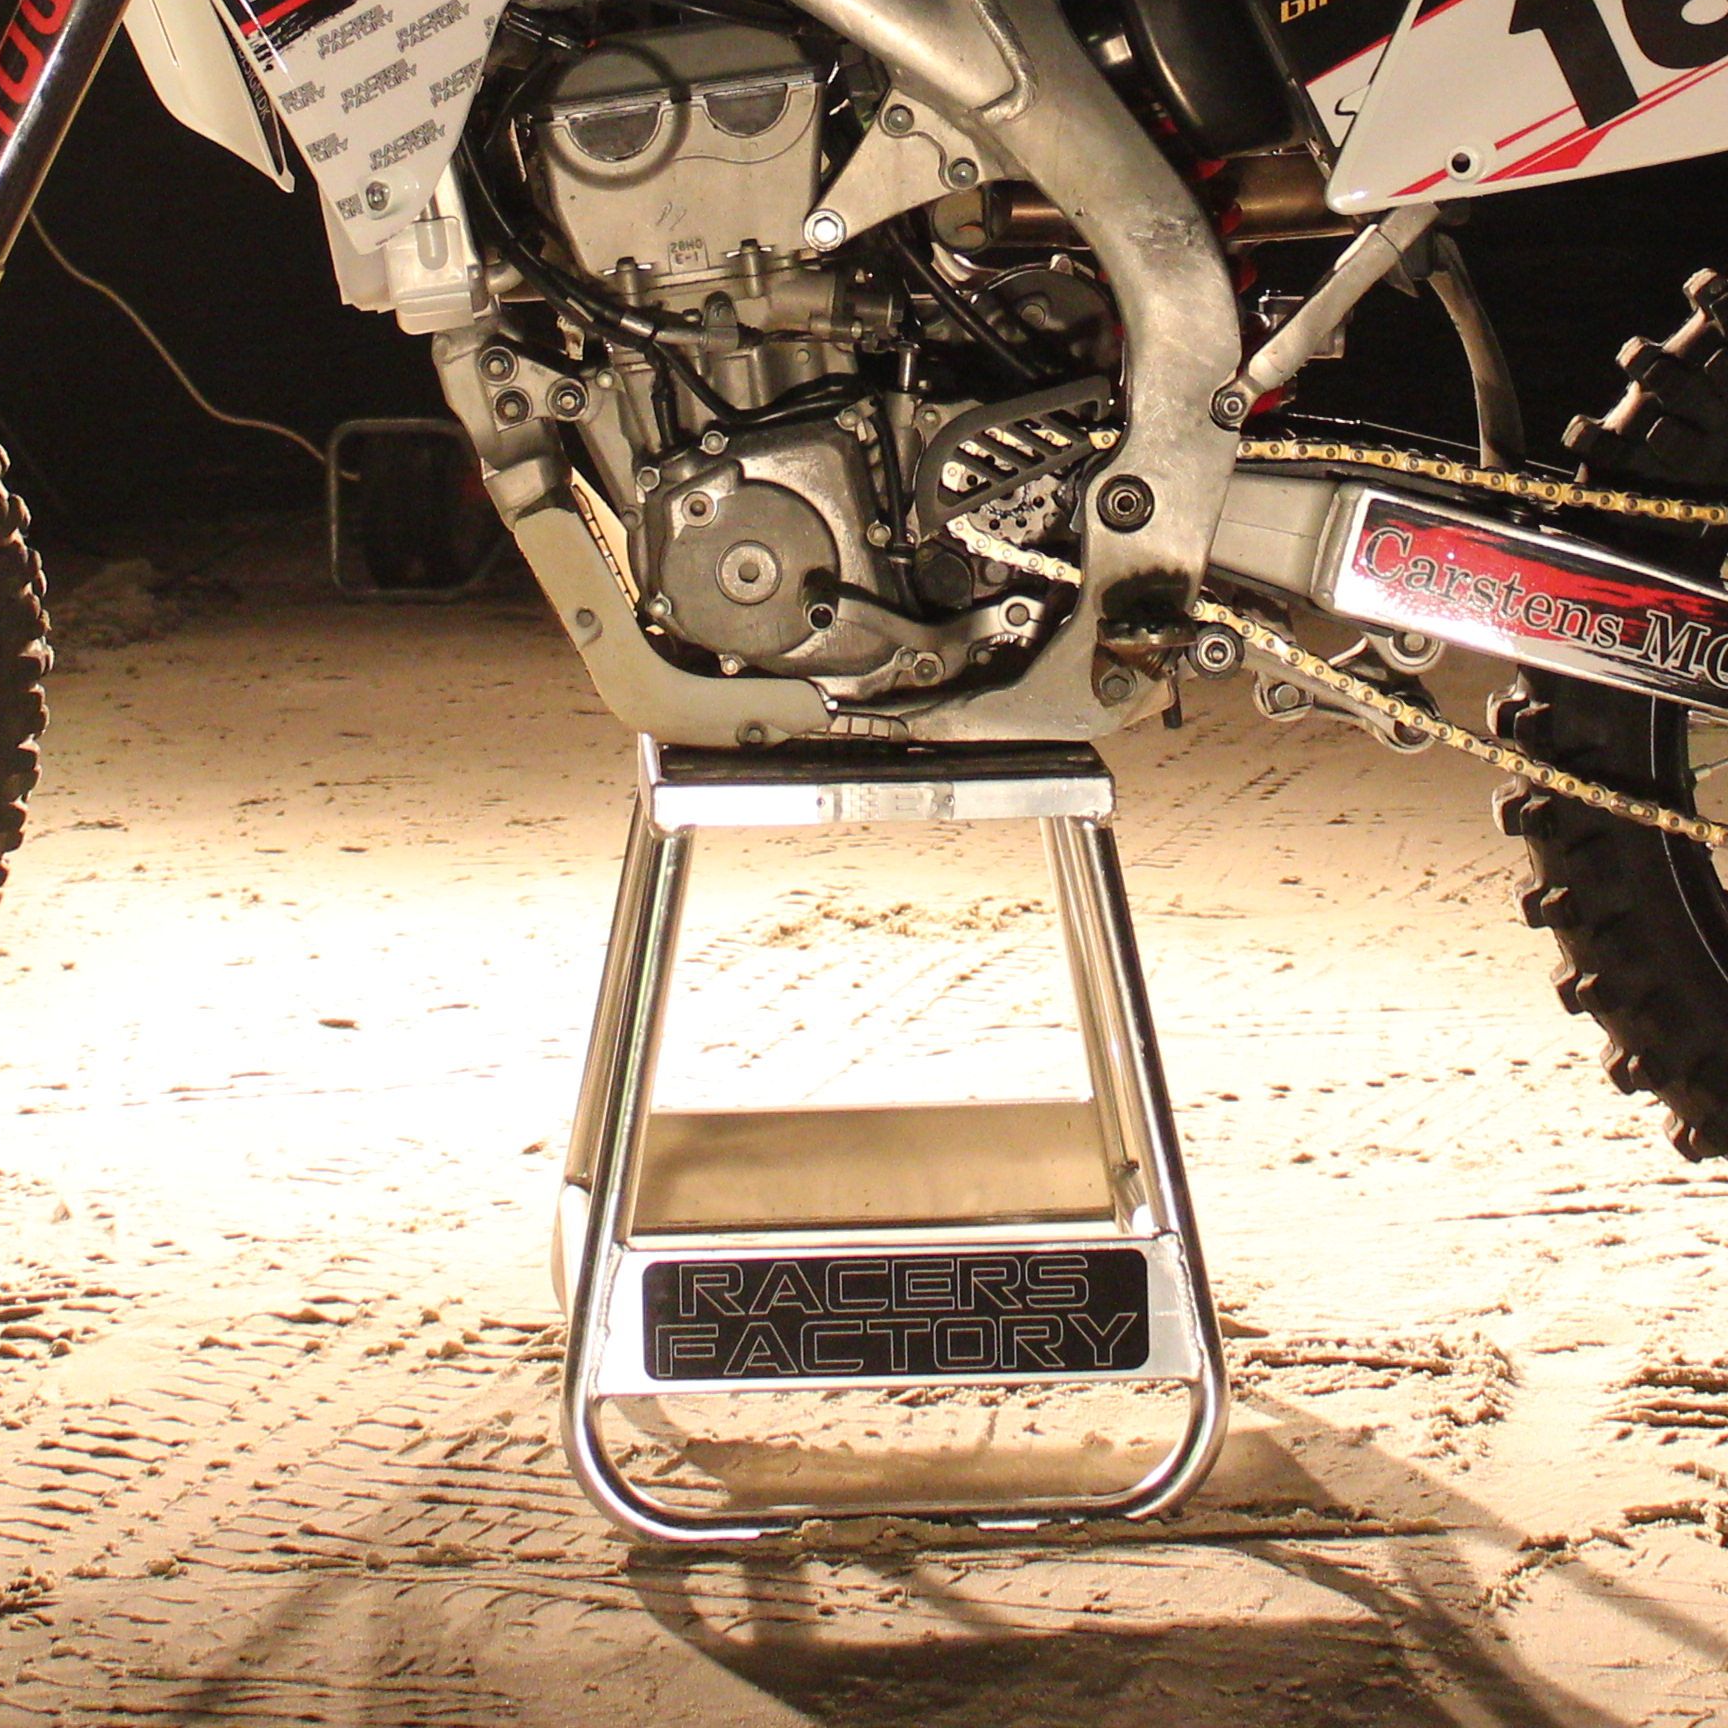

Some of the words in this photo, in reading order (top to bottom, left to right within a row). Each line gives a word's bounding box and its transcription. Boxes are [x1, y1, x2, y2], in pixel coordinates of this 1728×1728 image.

[1362, 526, 1625, 650] Carstens
[678, 1255, 1090, 1316] RACERS
[655, 1311, 1138, 1377] FACTORY
